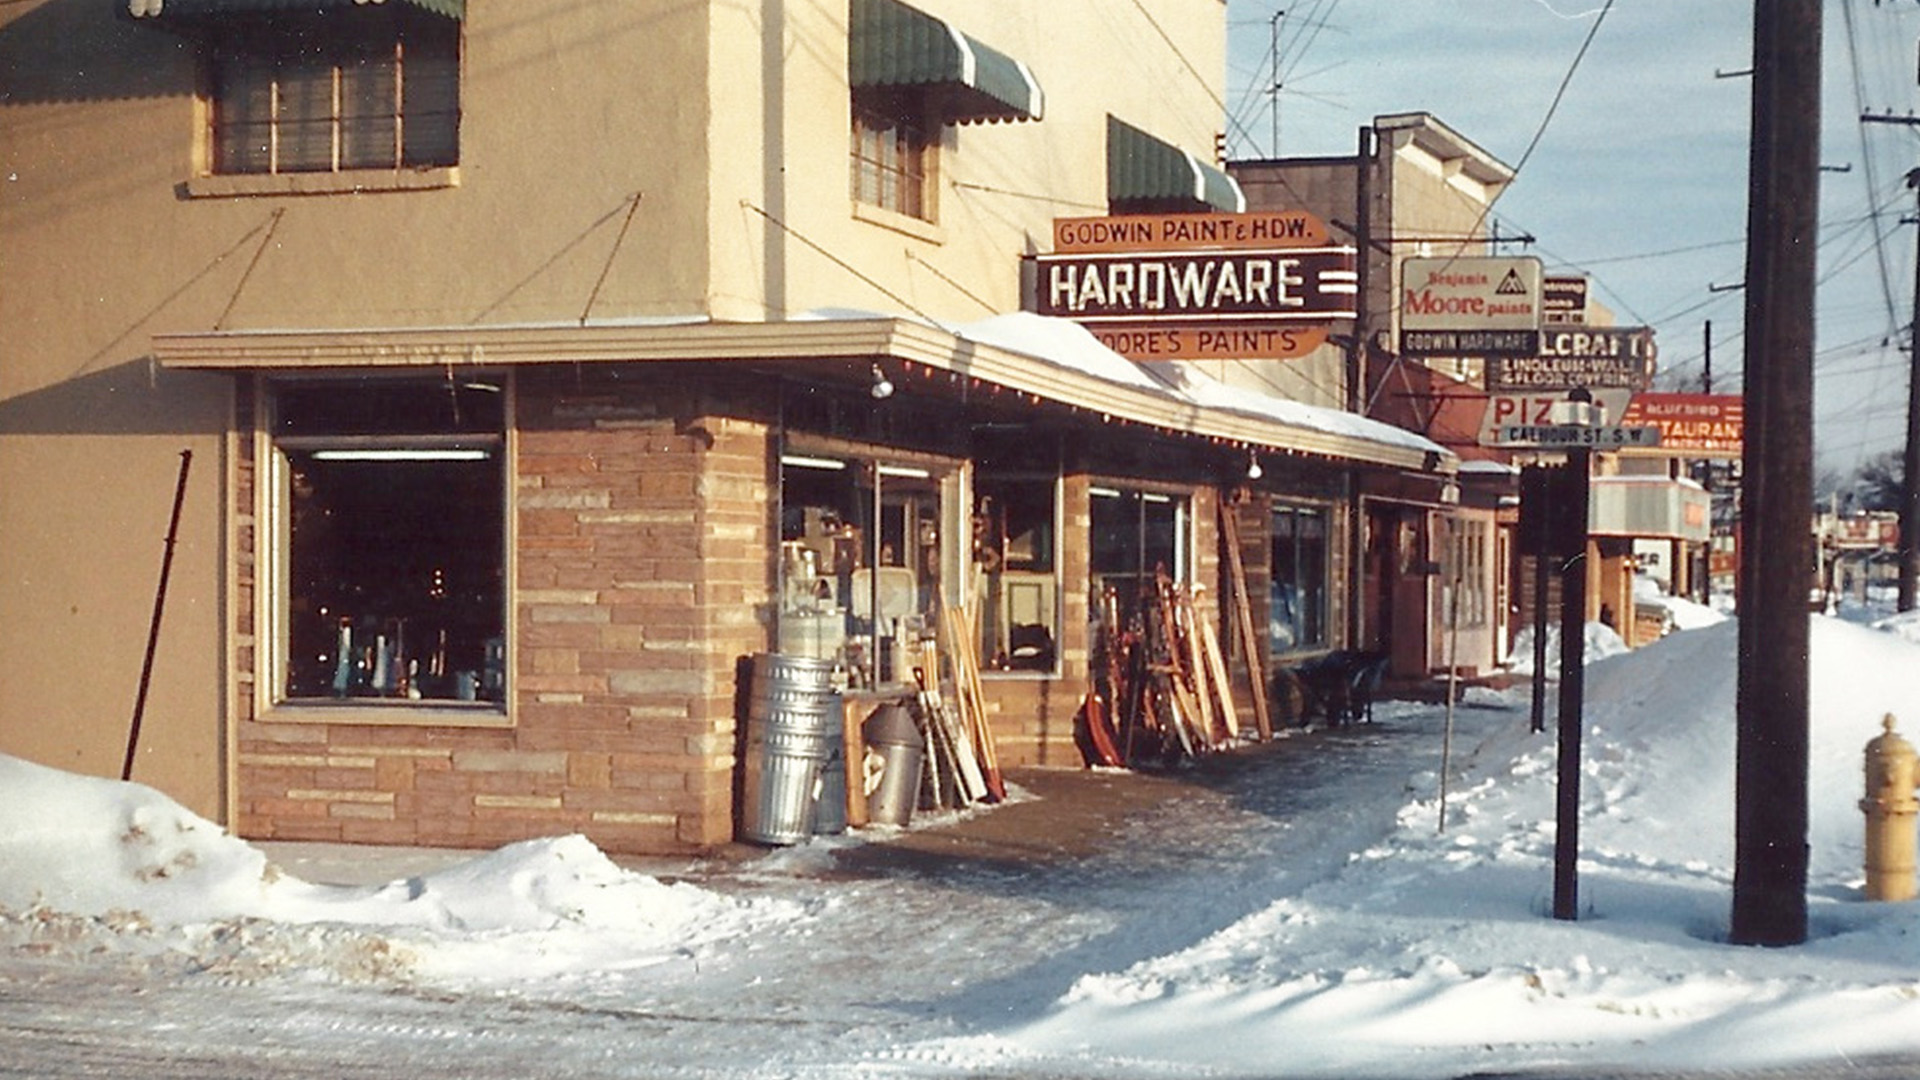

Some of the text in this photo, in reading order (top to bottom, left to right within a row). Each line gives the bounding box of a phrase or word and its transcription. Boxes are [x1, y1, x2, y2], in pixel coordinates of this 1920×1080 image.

[1059, 222, 1153, 246] GODWIN
[1162, 219, 1233, 242] PAINT
[1251, 218, 1314, 240] HDW.
[1050, 259, 1304, 310] HARDWARE
[1428, 271, 1488, 288] Benjamin
[1405, 288, 1484, 315] Moore
[1487, 302, 1533, 317] paints
[1098, 328, 1297, 354] OORE'S PAINTS
[1406, 333, 1529, 350] GODWIN HARDWARE
[1539, 333, 1642, 357] LCRAFT
[1494, 397, 1612, 425] PIZ
[1509, 428, 1578, 443] CALHOUN
[1622, 420, 1742, 438] TAURAN
